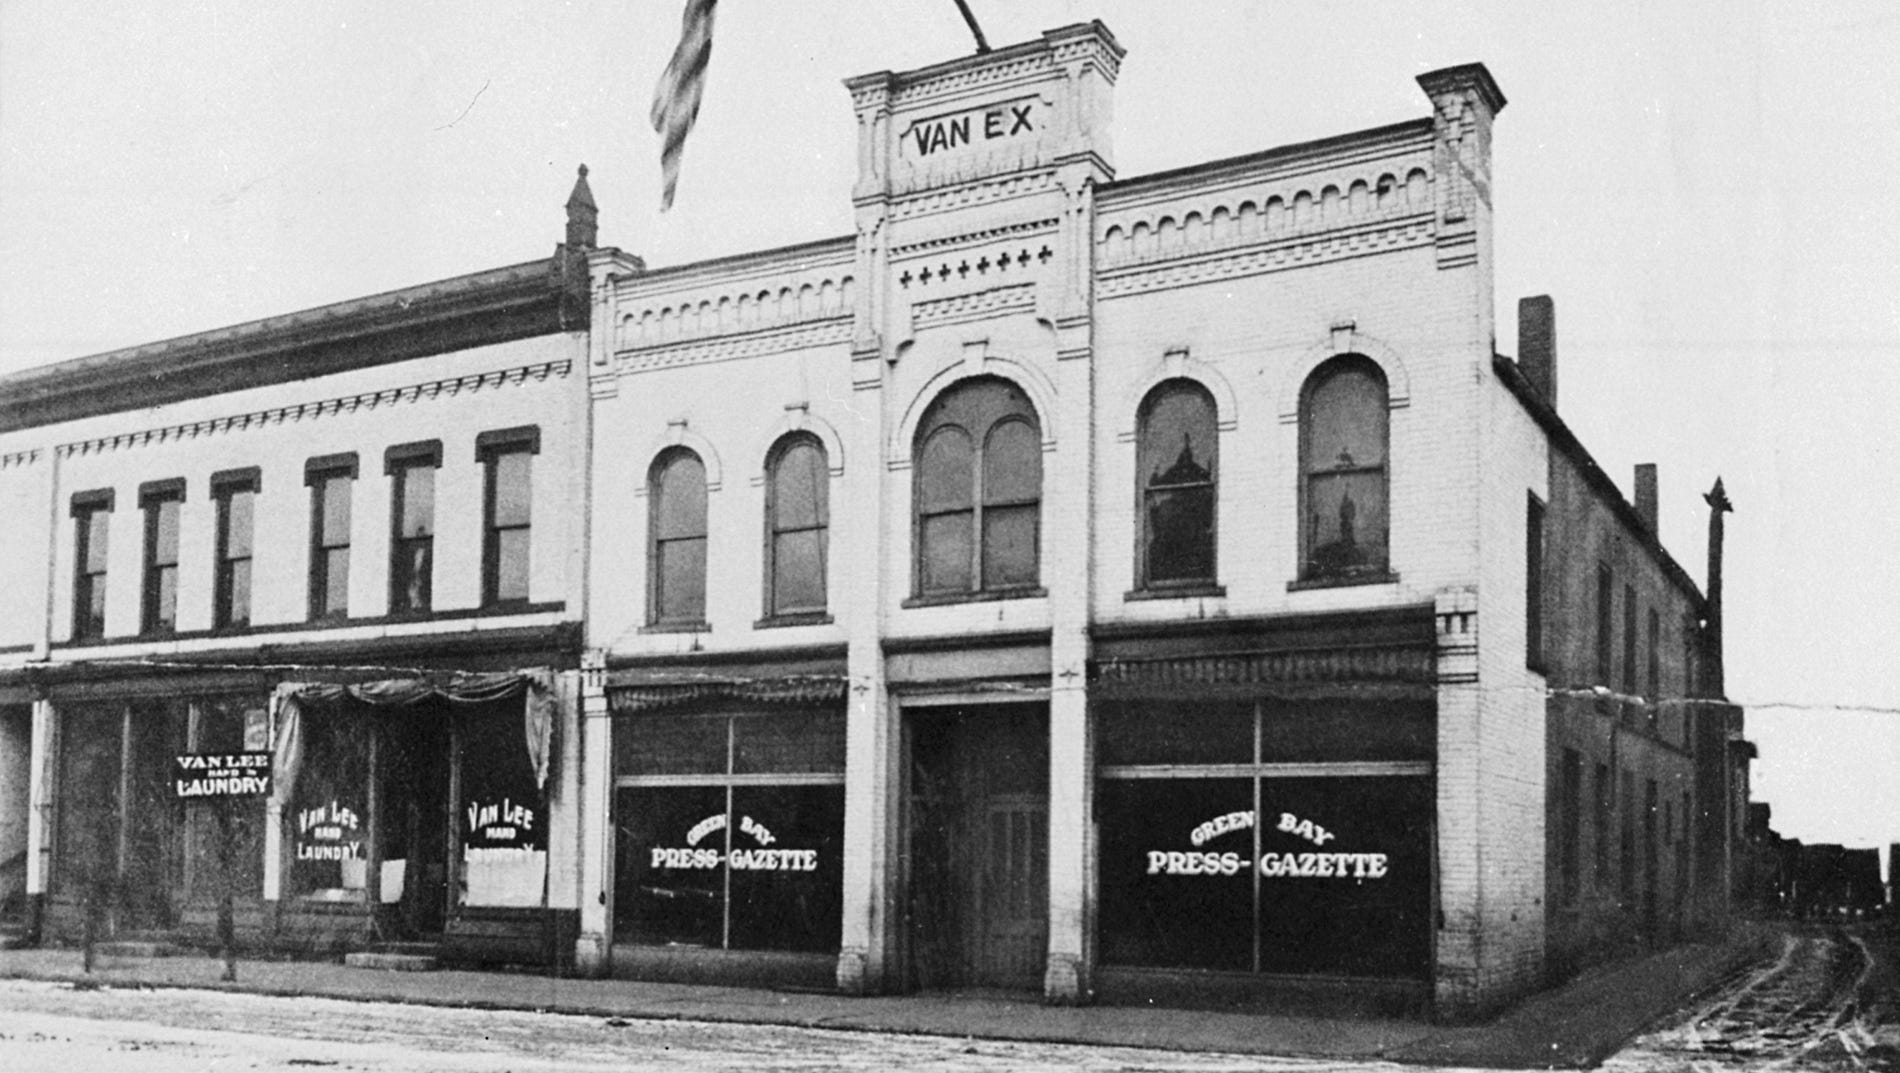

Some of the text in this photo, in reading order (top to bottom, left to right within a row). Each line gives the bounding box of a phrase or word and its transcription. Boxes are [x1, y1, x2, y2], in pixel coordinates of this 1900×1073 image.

[914, 104, 1033, 156] VAN EX
[176, 754, 268, 769] VAN LEE
[177, 776, 269, 796] LAUNDRY
[686, 813, 777, 847] GREEN BAY
[1190, 810, 1335, 847] GREEN BAY
[298, 841, 360, 861] LAUNDRY
